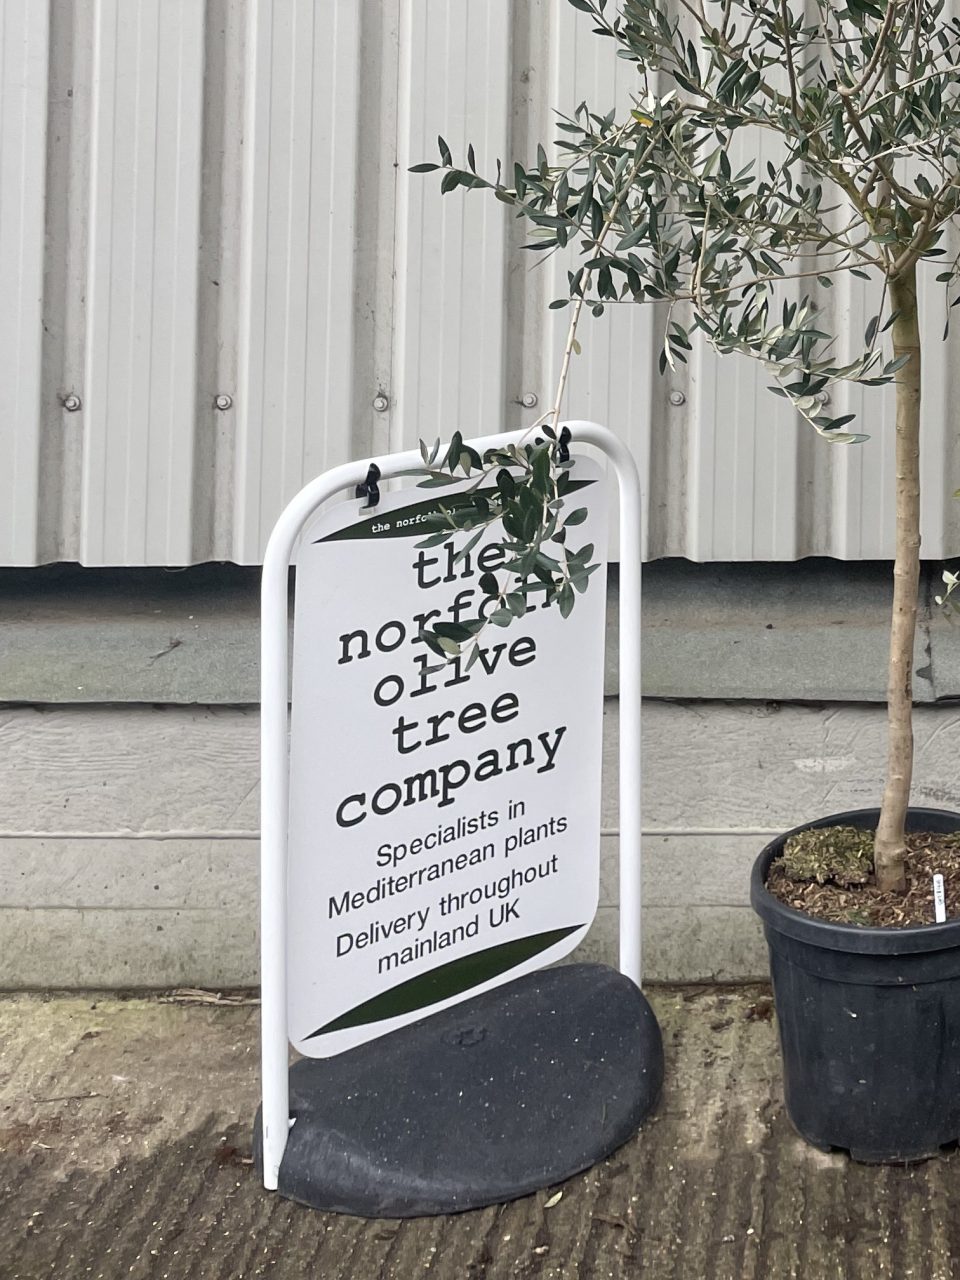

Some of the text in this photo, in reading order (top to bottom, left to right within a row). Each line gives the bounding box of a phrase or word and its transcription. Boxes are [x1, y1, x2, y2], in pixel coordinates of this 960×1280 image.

[372, 510, 437, 534] the norfo
[412, 541, 506, 589] the
[374, 636, 537, 707] olive
[392, 692, 520, 755] tree
[336, 725, 567, 828] company
[328, 815, 568, 919] Mediterranean plants
[377, 799, 526, 868] Specialists in
[336, 854, 559, 958] Delivery throughout
[378, 898, 521, 974] mainland UK
